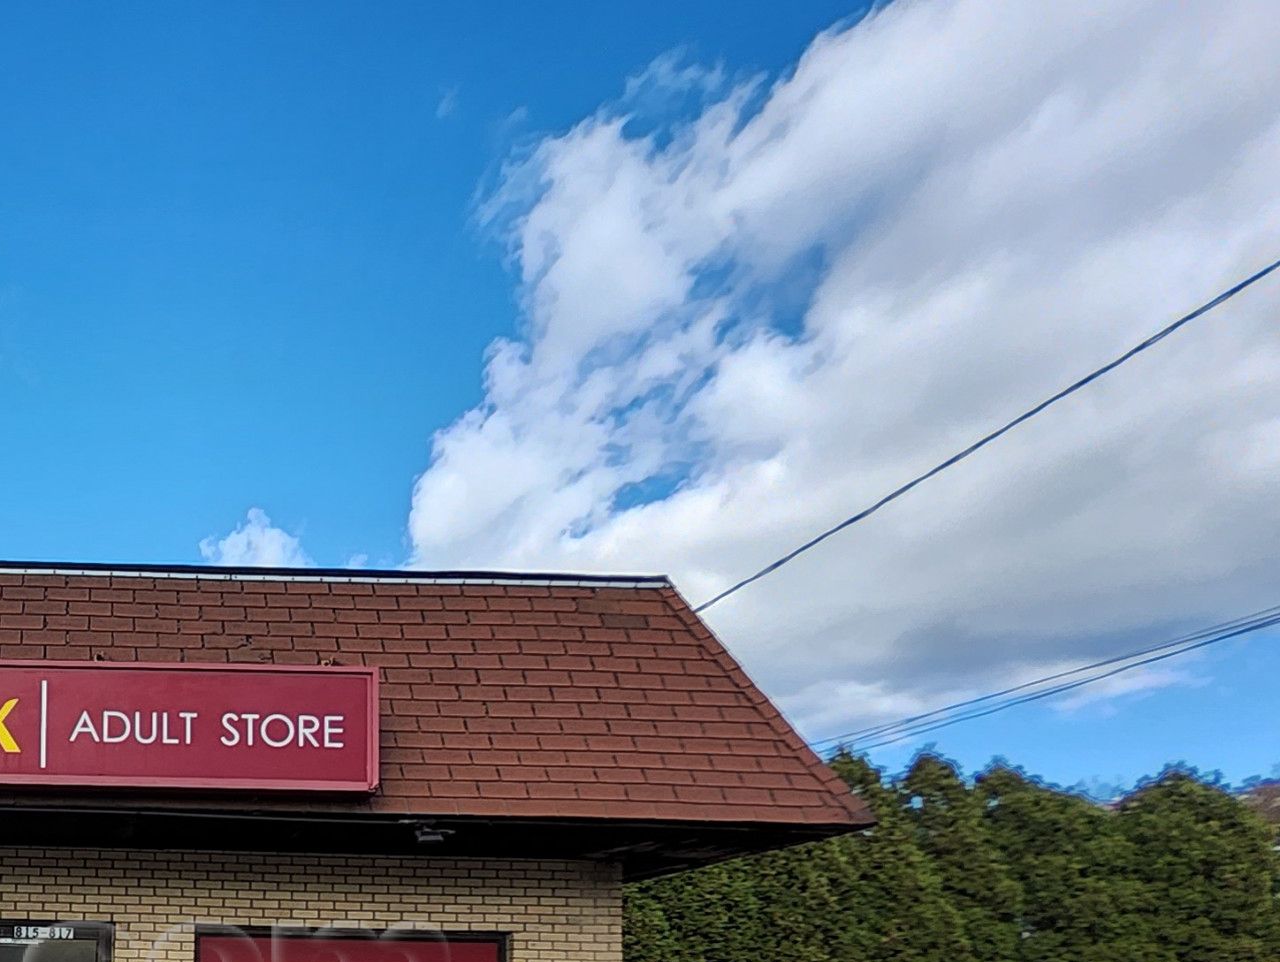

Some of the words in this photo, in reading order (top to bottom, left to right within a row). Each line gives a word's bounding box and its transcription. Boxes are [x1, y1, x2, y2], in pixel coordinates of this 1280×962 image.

[69, 711, 198, 744] ADULT
[220, 713, 344, 748] STORE
[15, 926, 72, 938] 815-817
